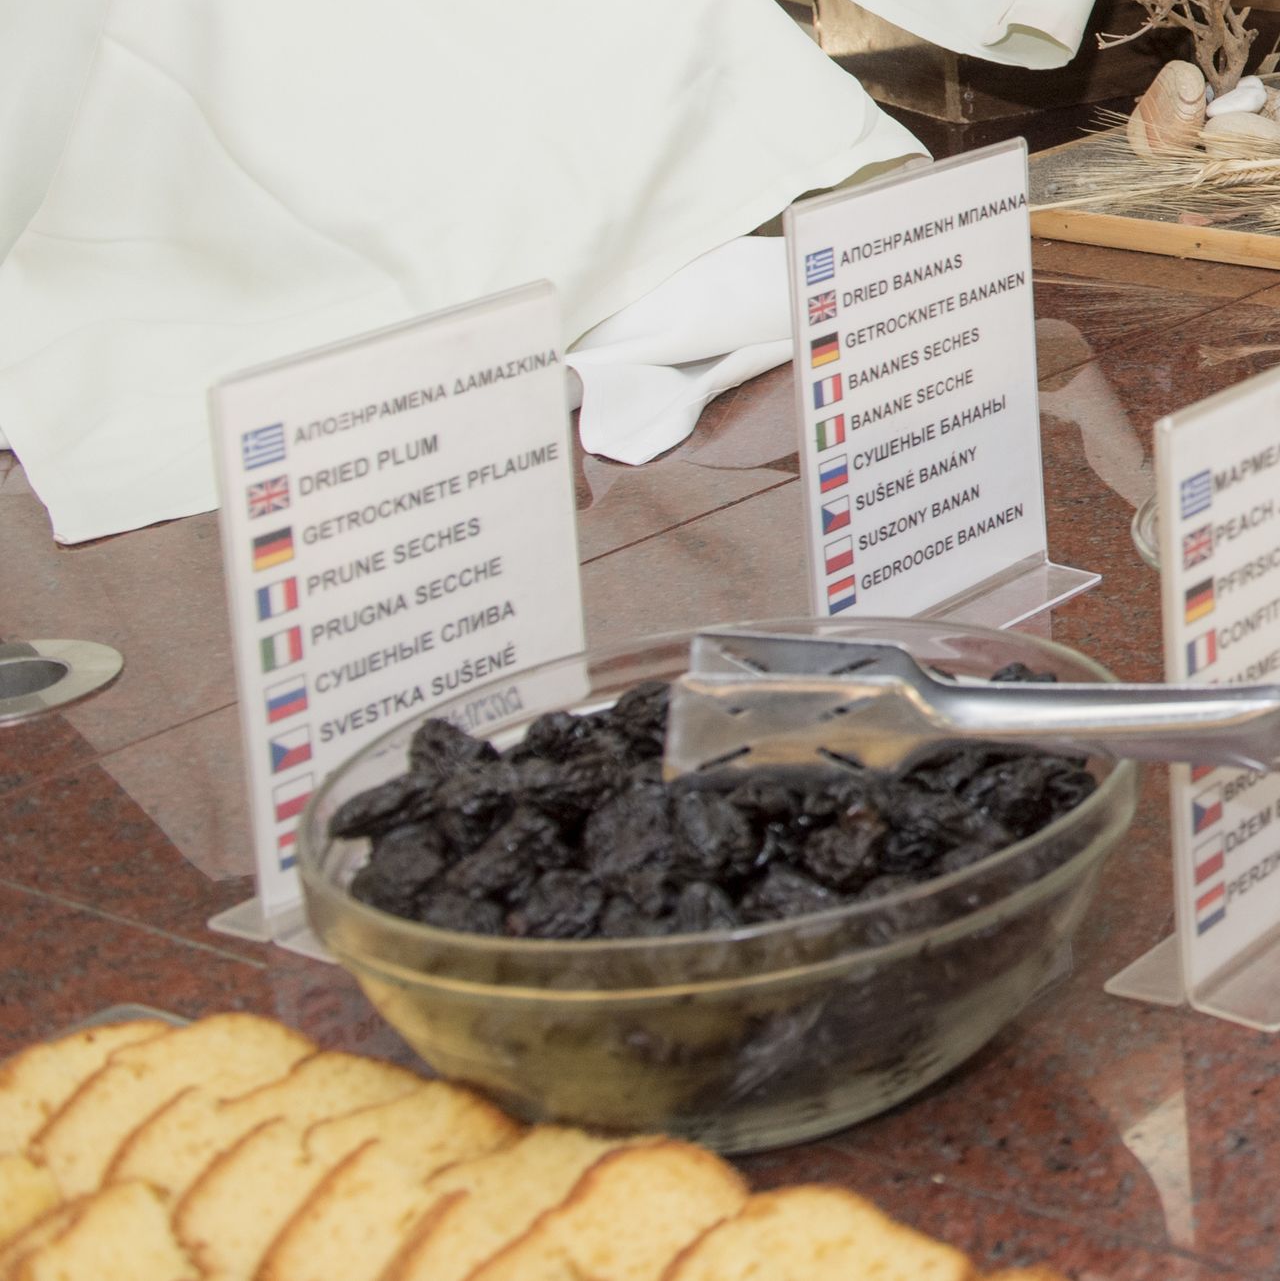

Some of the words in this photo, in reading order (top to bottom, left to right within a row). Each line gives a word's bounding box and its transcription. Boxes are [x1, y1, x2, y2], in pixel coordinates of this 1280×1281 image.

[843, 280, 888, 308] DRIED
[893, 254, 963, 290] BANANAS
[845, 296, 955, 348] GETROCKNETE
[959, 271, 1025, 307] BANANEN
[848, 350, 919, 390] BANANES
[923, 327, 979, 361] SECHES
[851, 393, 912, 431] BANANE
[917, 369, 973, 404] SECCHE
[853, 424, 936, 470] СУШЕНЫЕ
[940, 395, 1006, 435] БАНАНЫ
[299, 457, 370, 496] DRIED
[377, 434, 438, 470] PLUM
[303, 475, 461, 545] GETROCKNETE
[467, 442, 558, 488] PFLAUME
[856, 473, 915, 511] SUŠENÉ
[919, 446, 976, 484] BANÁNY
[859, 507, 927, 551] SUSZONY
[932, 484, 980, 518] BANAN
[861, 535, 954, 590] GEDROOGDE
[958, 503, 1023, 545] BANANEN
[1213, 502, 1273, 548] PEACH
[307, 551, 386, 595] PRUNE
[394, 517, 481, 564] SECHES
[311, 594, 408, 645] PRUGNA
[415, 556, 502, 605] SECCHE
[315, 631, 435, 693] СУШЕНЫЕ
[441, 601, 515, 643] СЛИВА
[320, 686, 425, 743] SVESTKA
[432, 646, 516, 696] SUŠENÉ
